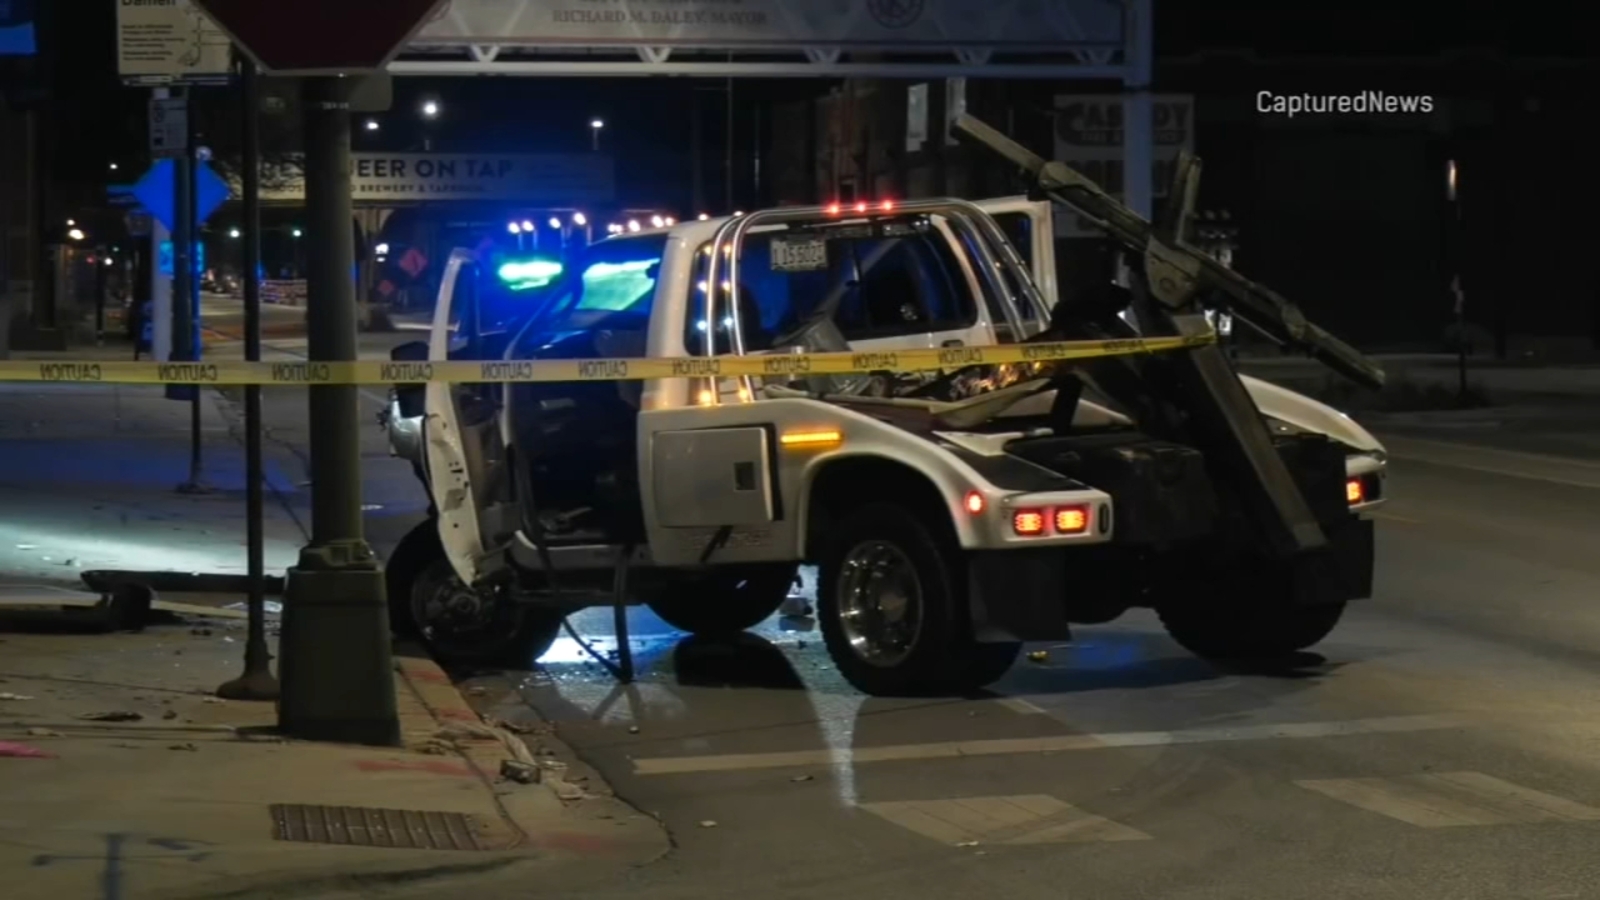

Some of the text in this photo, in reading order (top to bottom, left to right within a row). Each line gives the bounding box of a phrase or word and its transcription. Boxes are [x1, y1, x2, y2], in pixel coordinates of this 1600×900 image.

[553, 9, 626, 22] RICHARD
[711, 10, 767, 24] MAYOR
[350, 159, 406, 177] EER
[415, 159, 455, 177] ON
[465, 159, 513, 177] TAP
